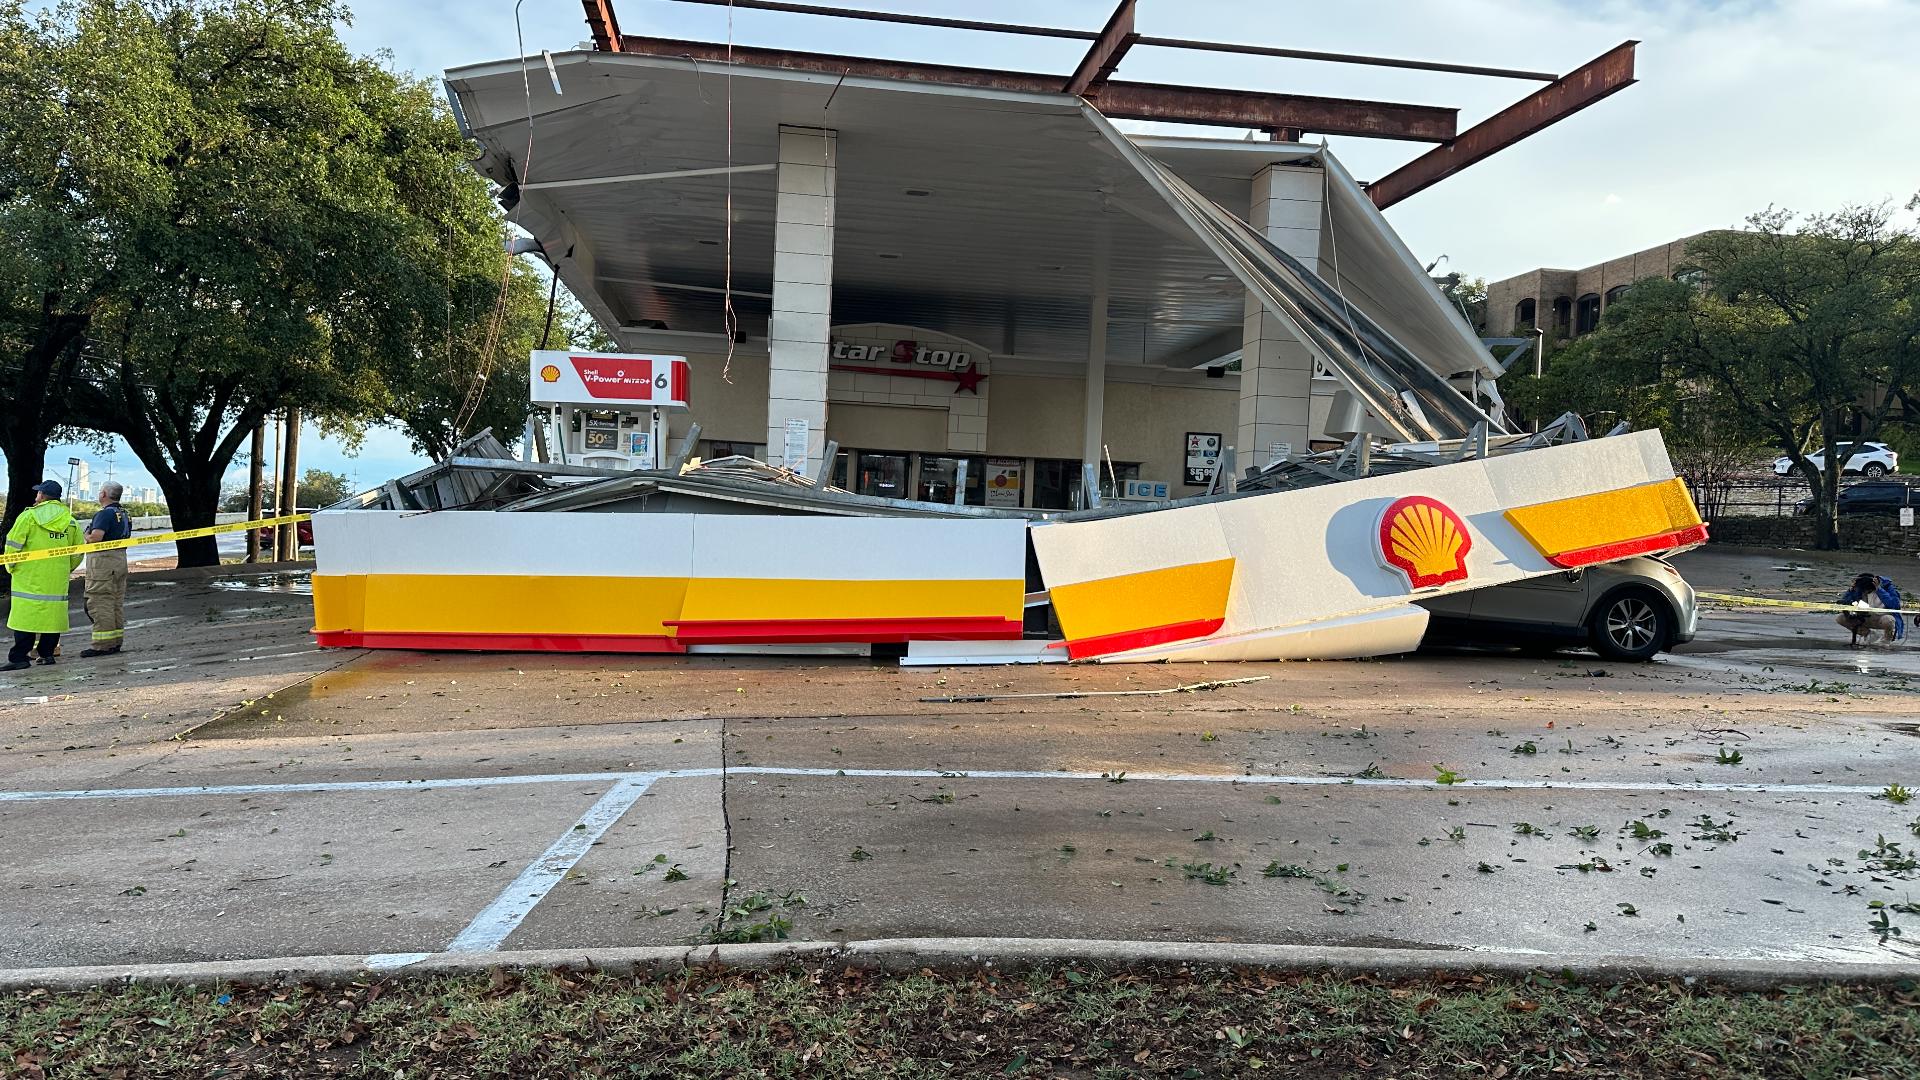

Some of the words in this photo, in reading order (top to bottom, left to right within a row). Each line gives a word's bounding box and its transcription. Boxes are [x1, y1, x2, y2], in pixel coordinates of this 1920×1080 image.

[832, 341, 885, 361] tar
[891, 340, 970, 371] Stop
[584, 374, 622, 384] V-Power
[654, 373, 668, 389] 6
[1128, 482, 1168, 498] ICE
[49, 532, 69, 540] DEPT
